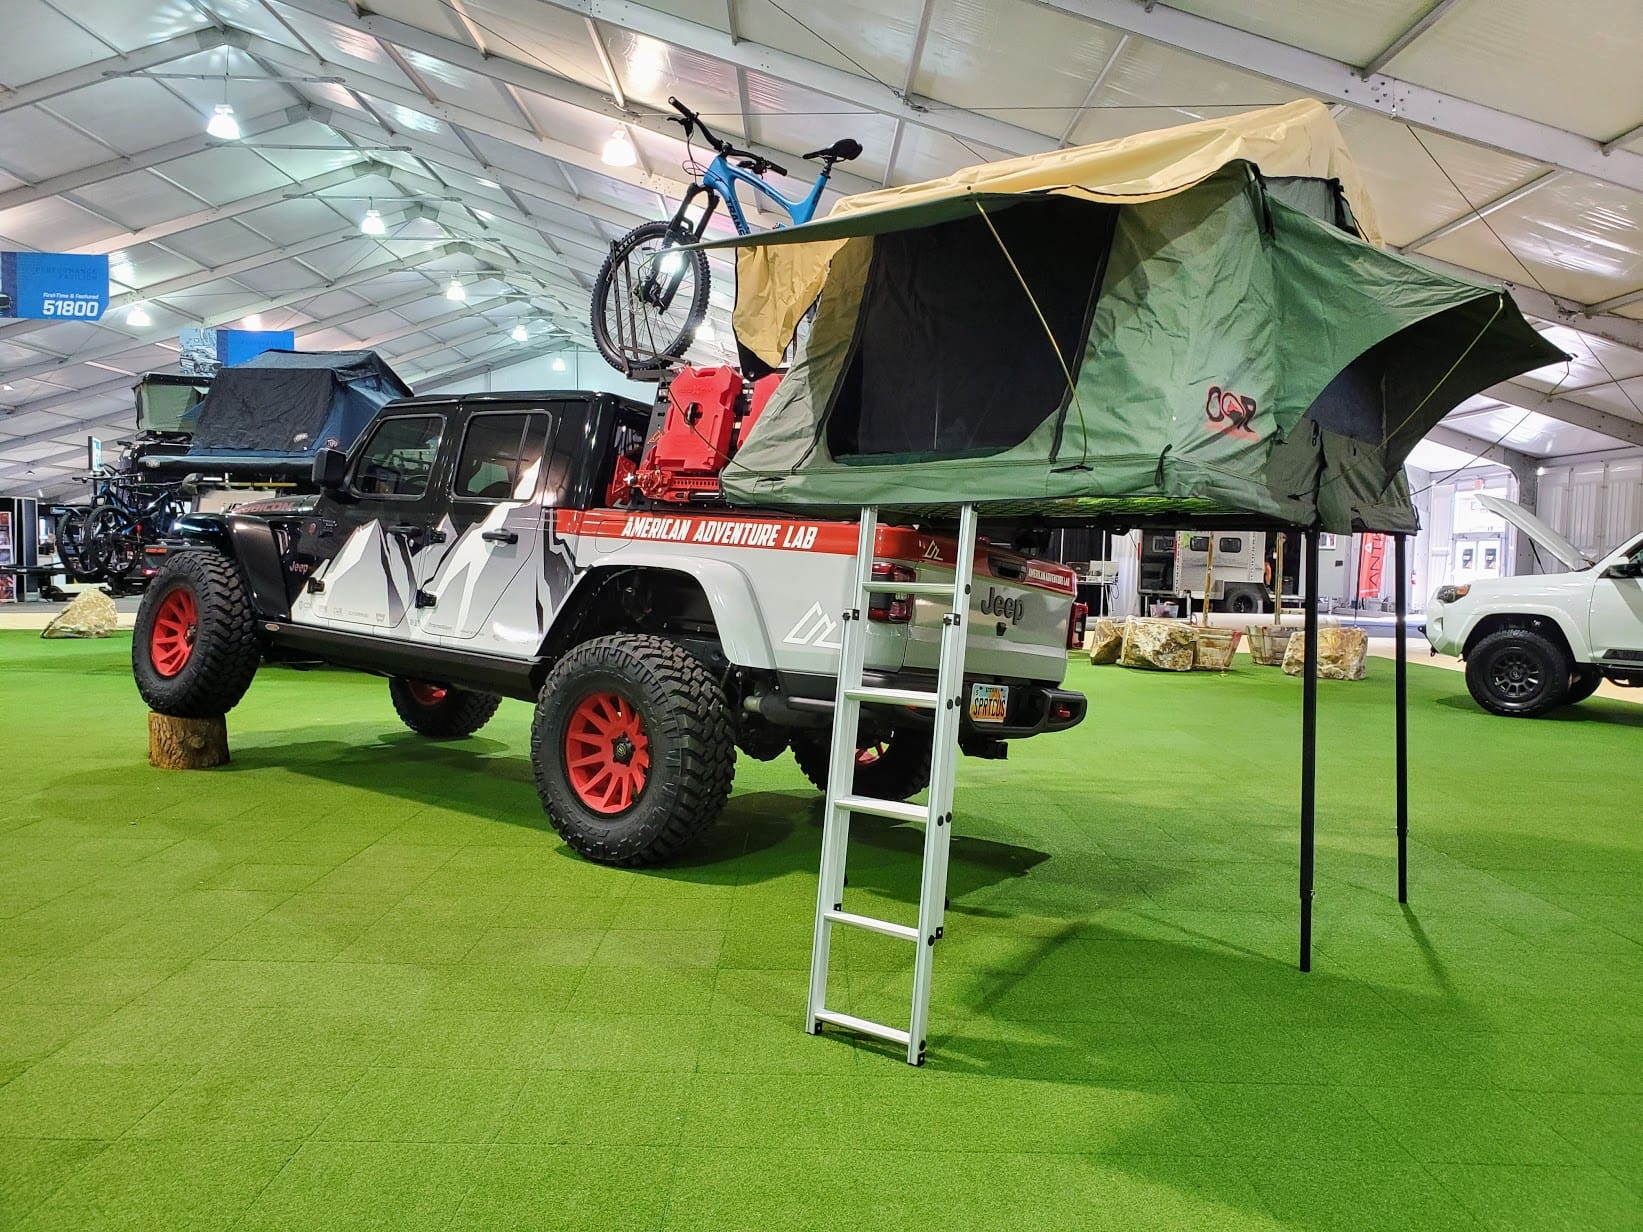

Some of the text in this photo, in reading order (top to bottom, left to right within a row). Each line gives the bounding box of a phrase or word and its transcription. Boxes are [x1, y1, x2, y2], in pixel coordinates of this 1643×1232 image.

[43, 299, 99, 317] 51800
[621, 516, 818, 549] AMERICAN ADVENTURE LAB
[289, 561, 309, 575] Jeep
[980, 586, 1024, 625] Jeep
